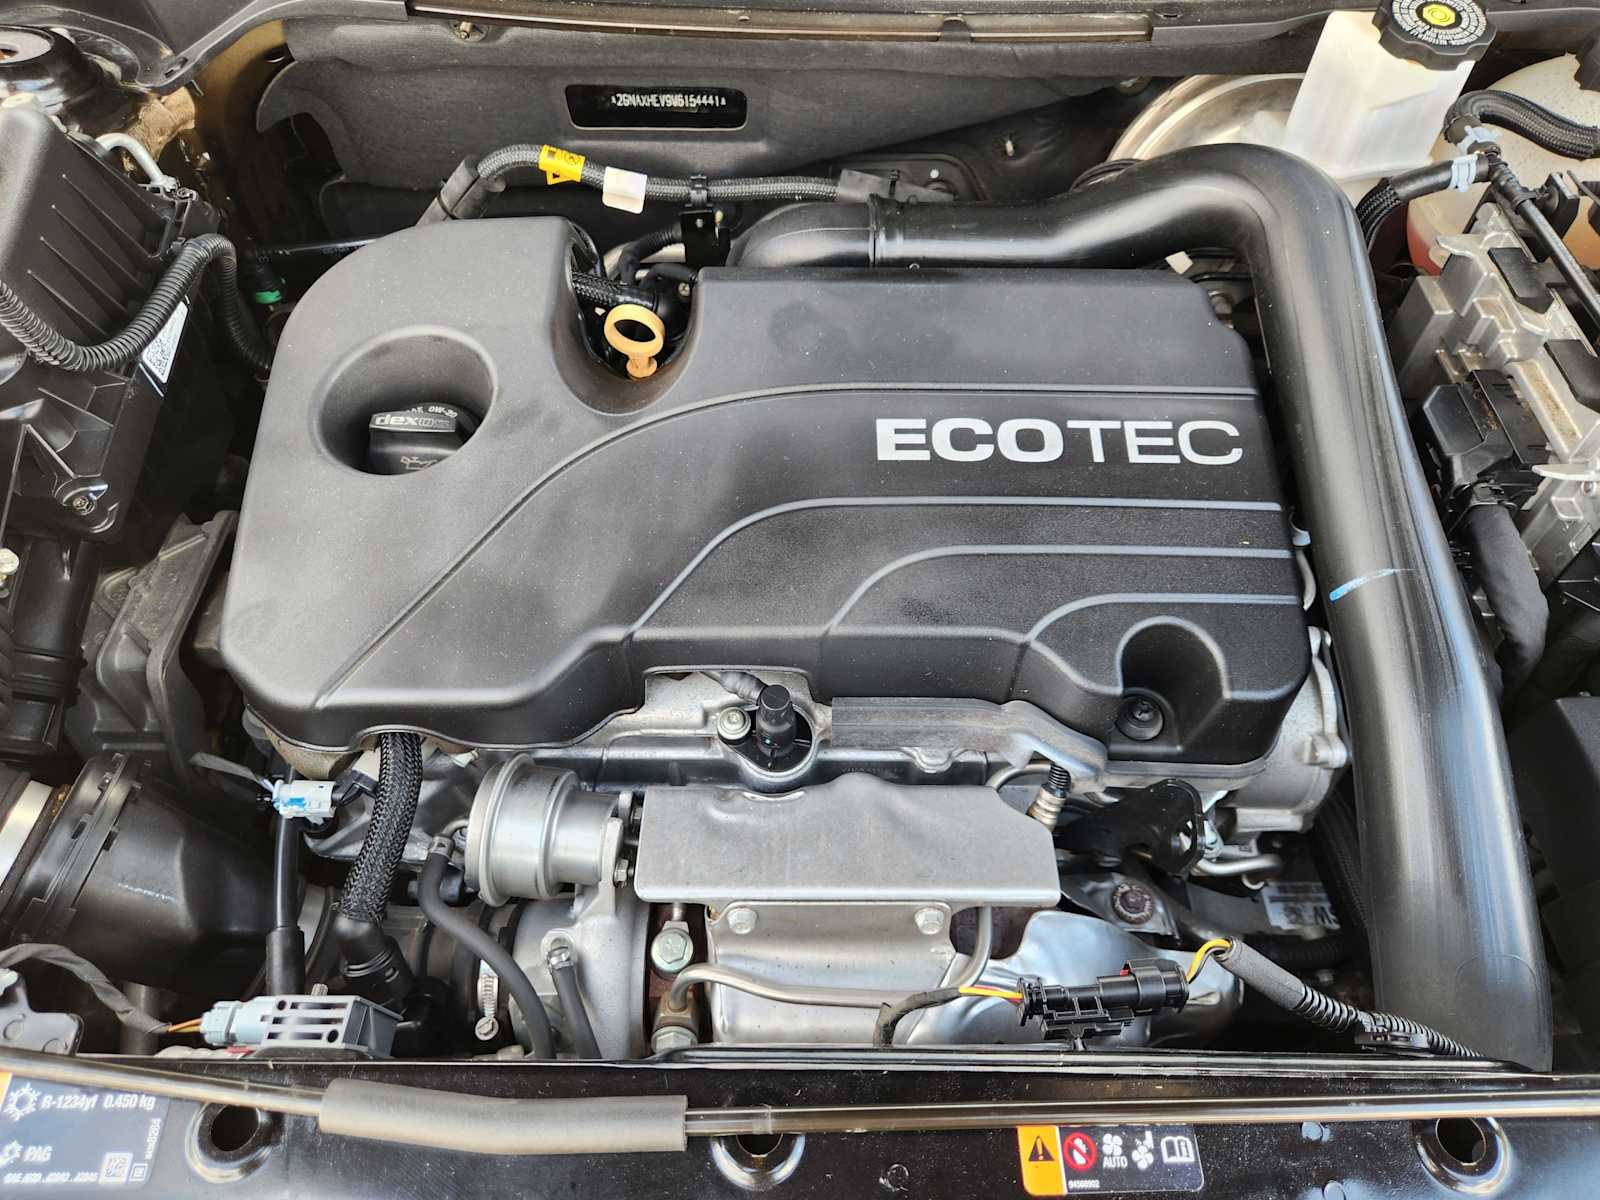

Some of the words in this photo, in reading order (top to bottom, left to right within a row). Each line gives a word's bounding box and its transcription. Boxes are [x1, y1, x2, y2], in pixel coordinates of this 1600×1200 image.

[875, 417, 1243, 465] ECOTEC
[103, 1093, 137, 1109] 0.450
[138, 1094, 156, 1111] kg
[23, 1145, 53, 1162] PAG
[1102, 1155, 1128, 1169] AUTO
